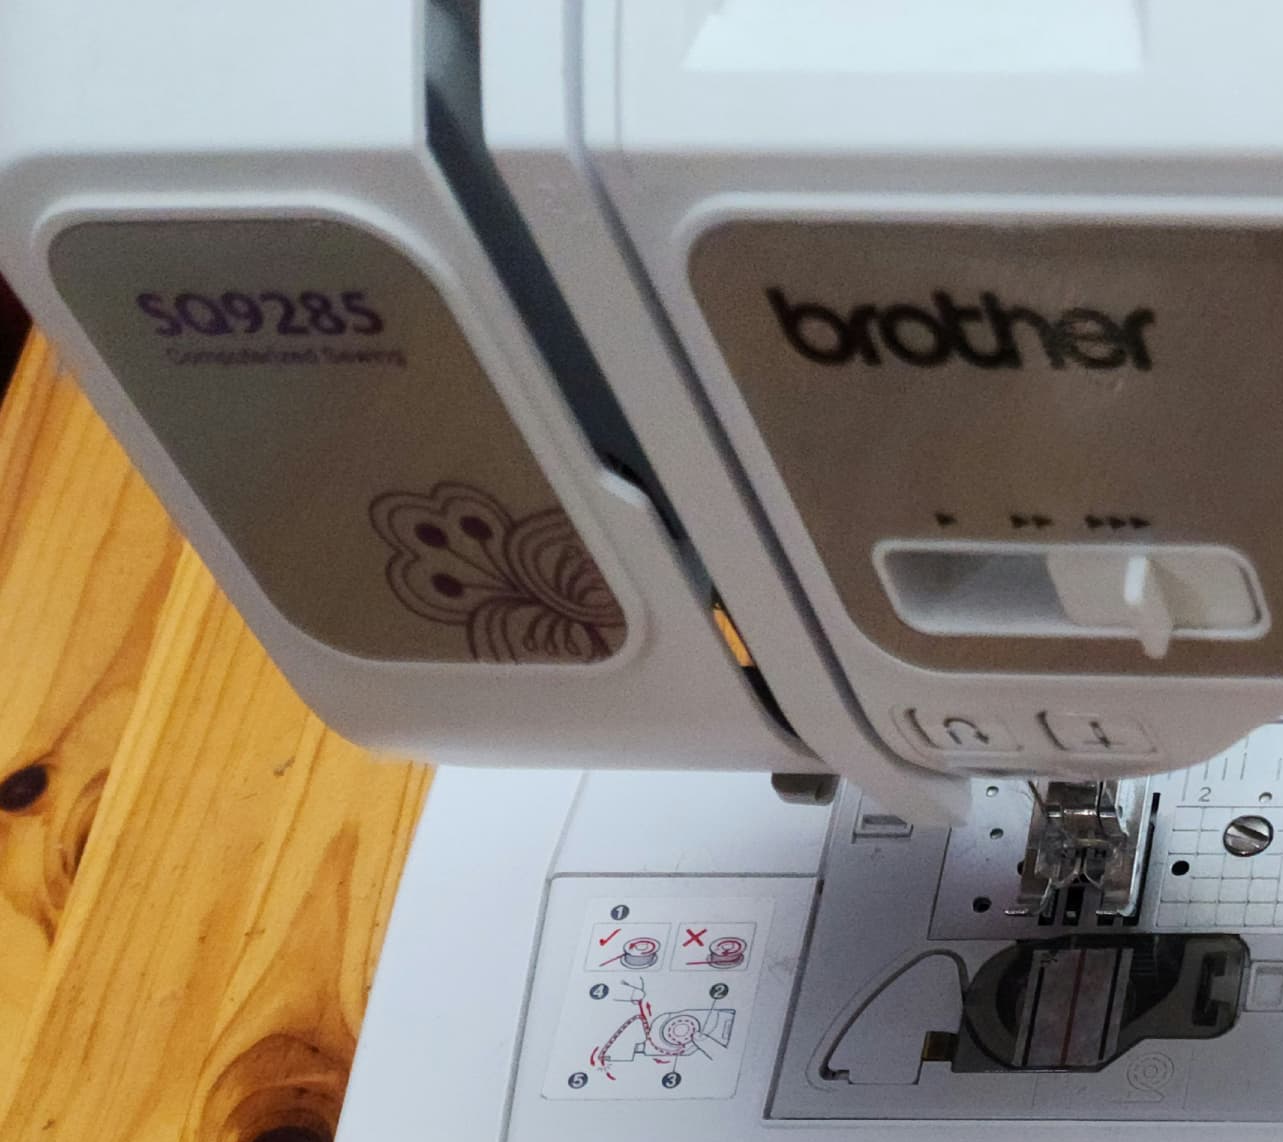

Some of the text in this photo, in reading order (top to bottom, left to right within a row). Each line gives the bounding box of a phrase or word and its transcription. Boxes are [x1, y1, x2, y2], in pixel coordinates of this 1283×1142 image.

[135, 291, 385, 337] SQ9285
[766, 287, 1156, 371] brother
[1199, 787, 1212, 802] 2
